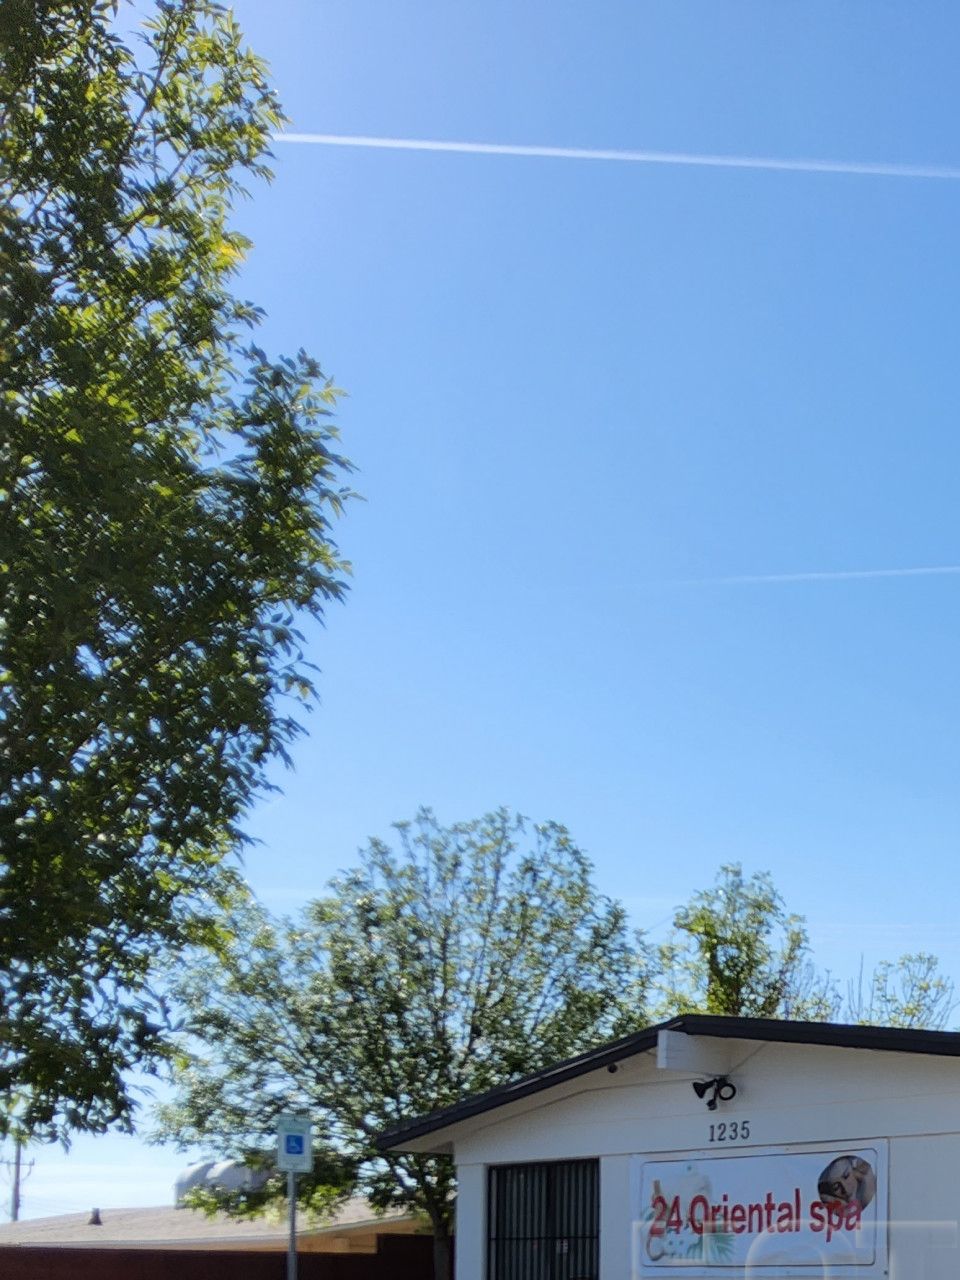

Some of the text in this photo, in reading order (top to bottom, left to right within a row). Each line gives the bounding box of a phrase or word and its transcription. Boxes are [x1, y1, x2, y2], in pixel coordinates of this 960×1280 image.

[708, 1120, 751, 1142] 1235
[649, 1188, 862, 1243] 24 Oriental spa
